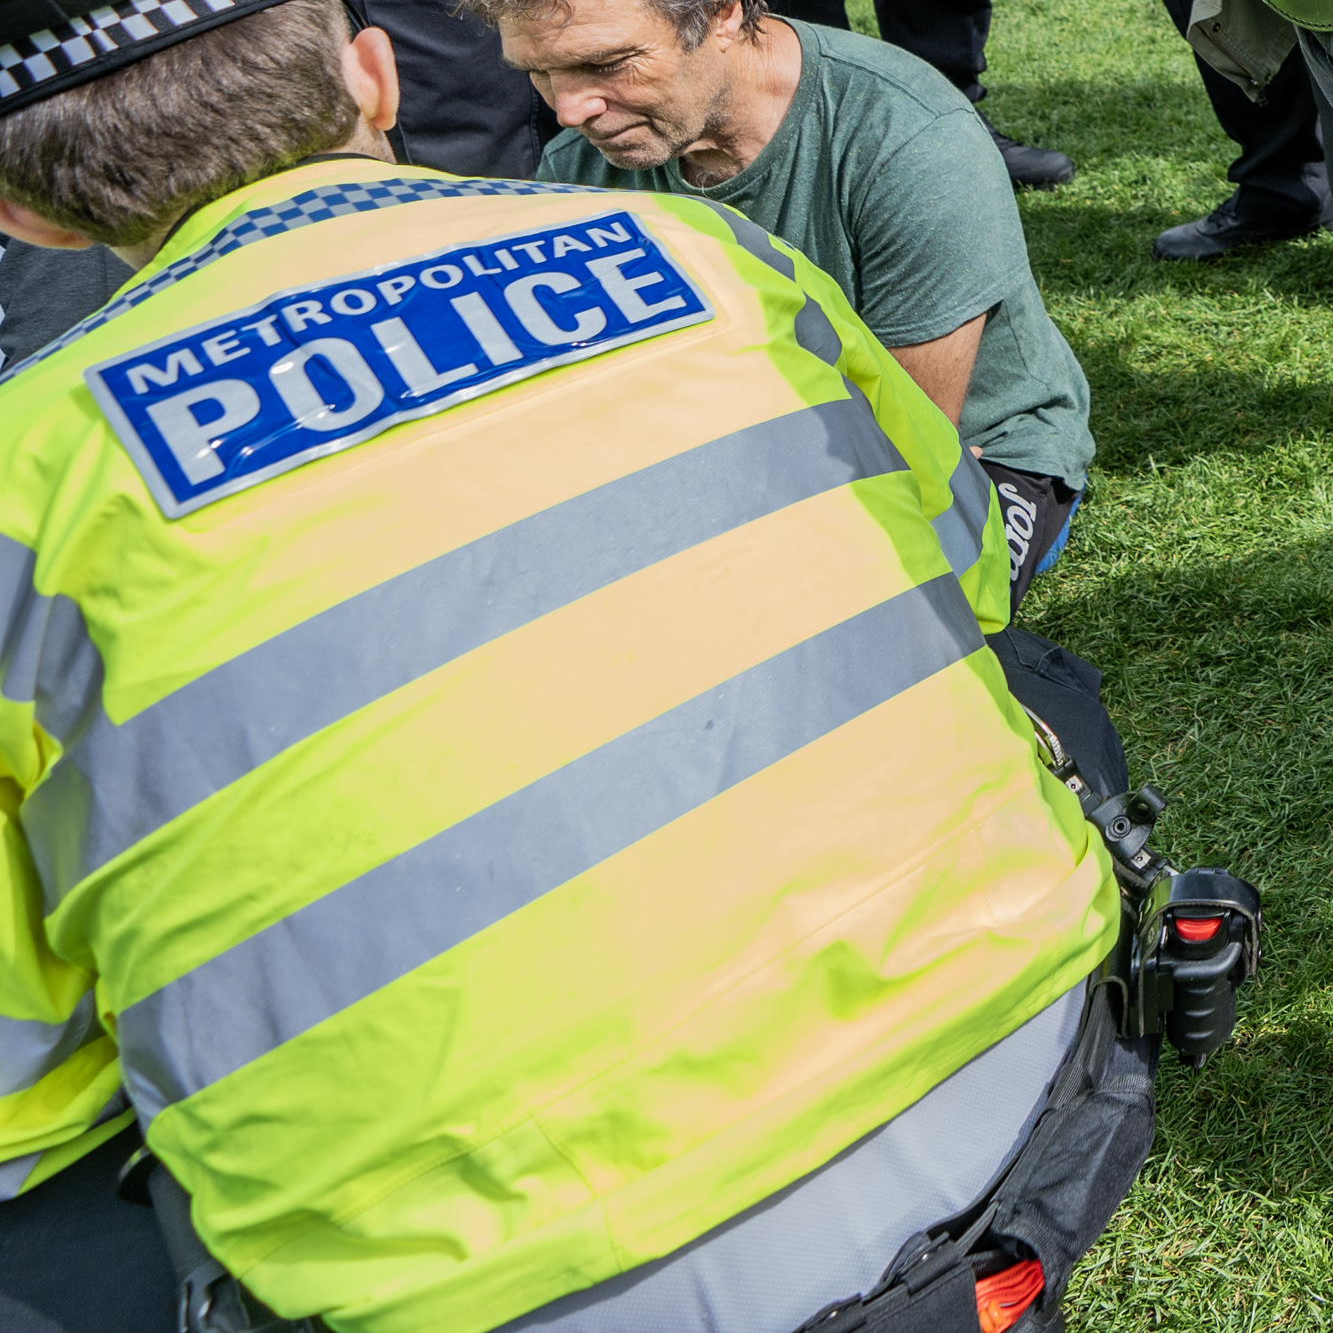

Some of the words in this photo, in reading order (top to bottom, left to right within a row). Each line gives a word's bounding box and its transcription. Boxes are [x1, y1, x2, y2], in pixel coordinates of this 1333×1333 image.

[127, 219, 631, 395] METROPOLITAN
[147, 249, 687, 486] POLICE
[998, 482, 1037, 582] Jom
